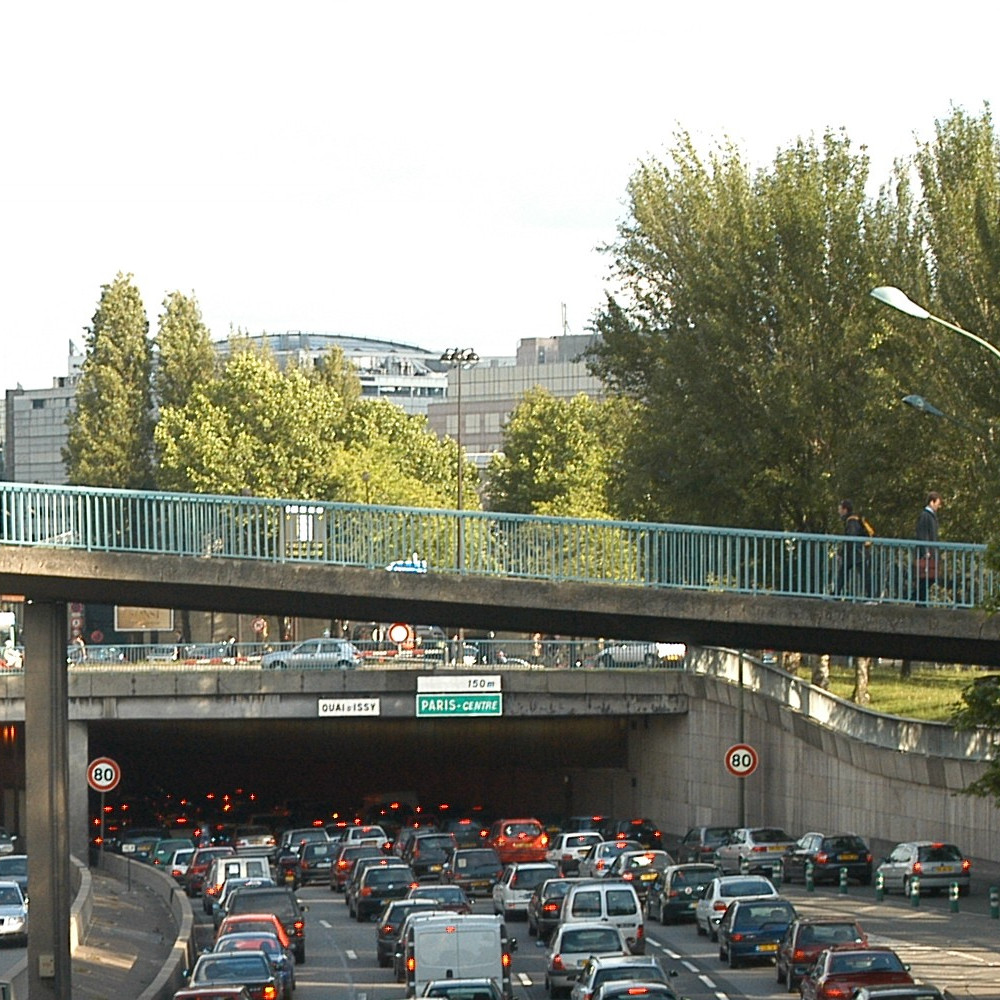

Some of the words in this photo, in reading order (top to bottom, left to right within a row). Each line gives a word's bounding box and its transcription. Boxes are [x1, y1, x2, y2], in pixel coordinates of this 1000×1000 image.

[322, 703, 345, 712] QUAI
[732, 754, 751, 767] 80
[94, 768, 113, 781] 80
